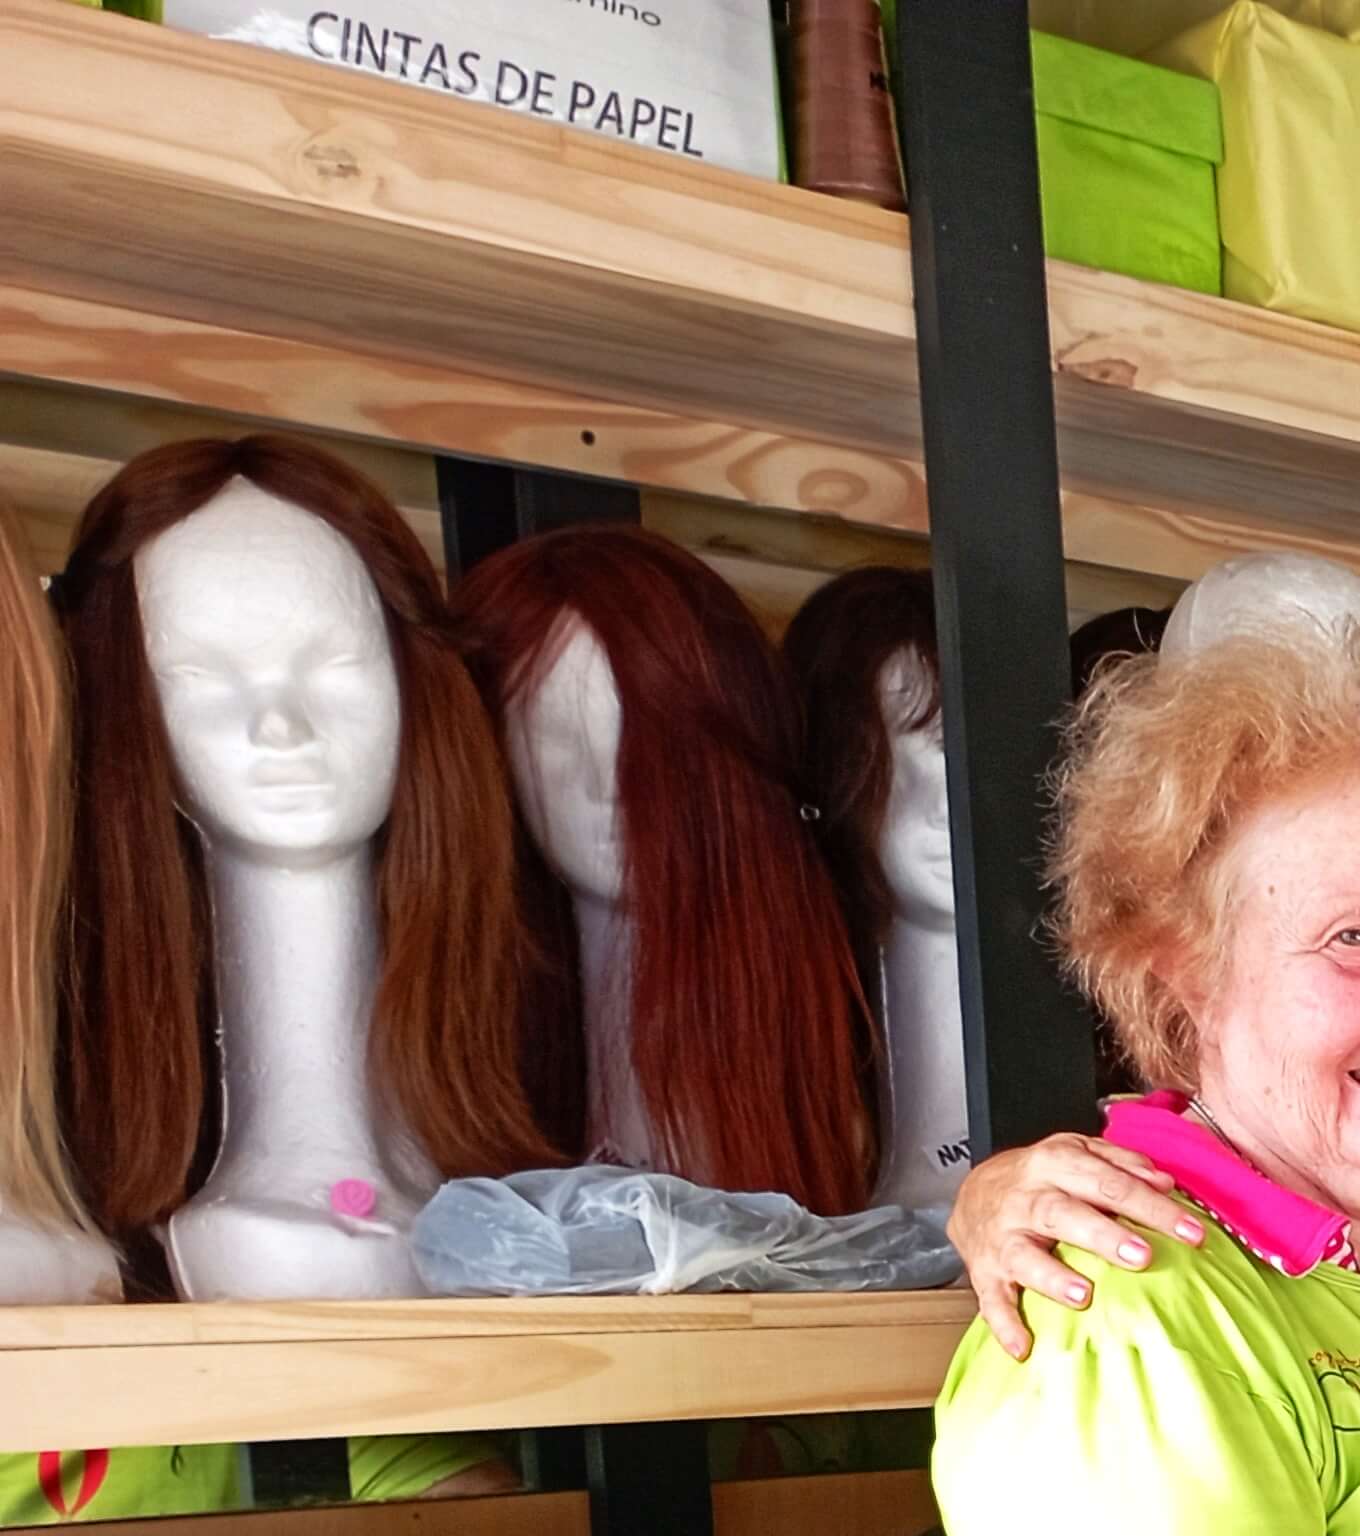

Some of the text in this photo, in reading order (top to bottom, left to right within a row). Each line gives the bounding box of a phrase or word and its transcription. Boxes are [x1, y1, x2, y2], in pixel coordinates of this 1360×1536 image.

[307, 12, 703, 157] CINTAS DE PAPEL
